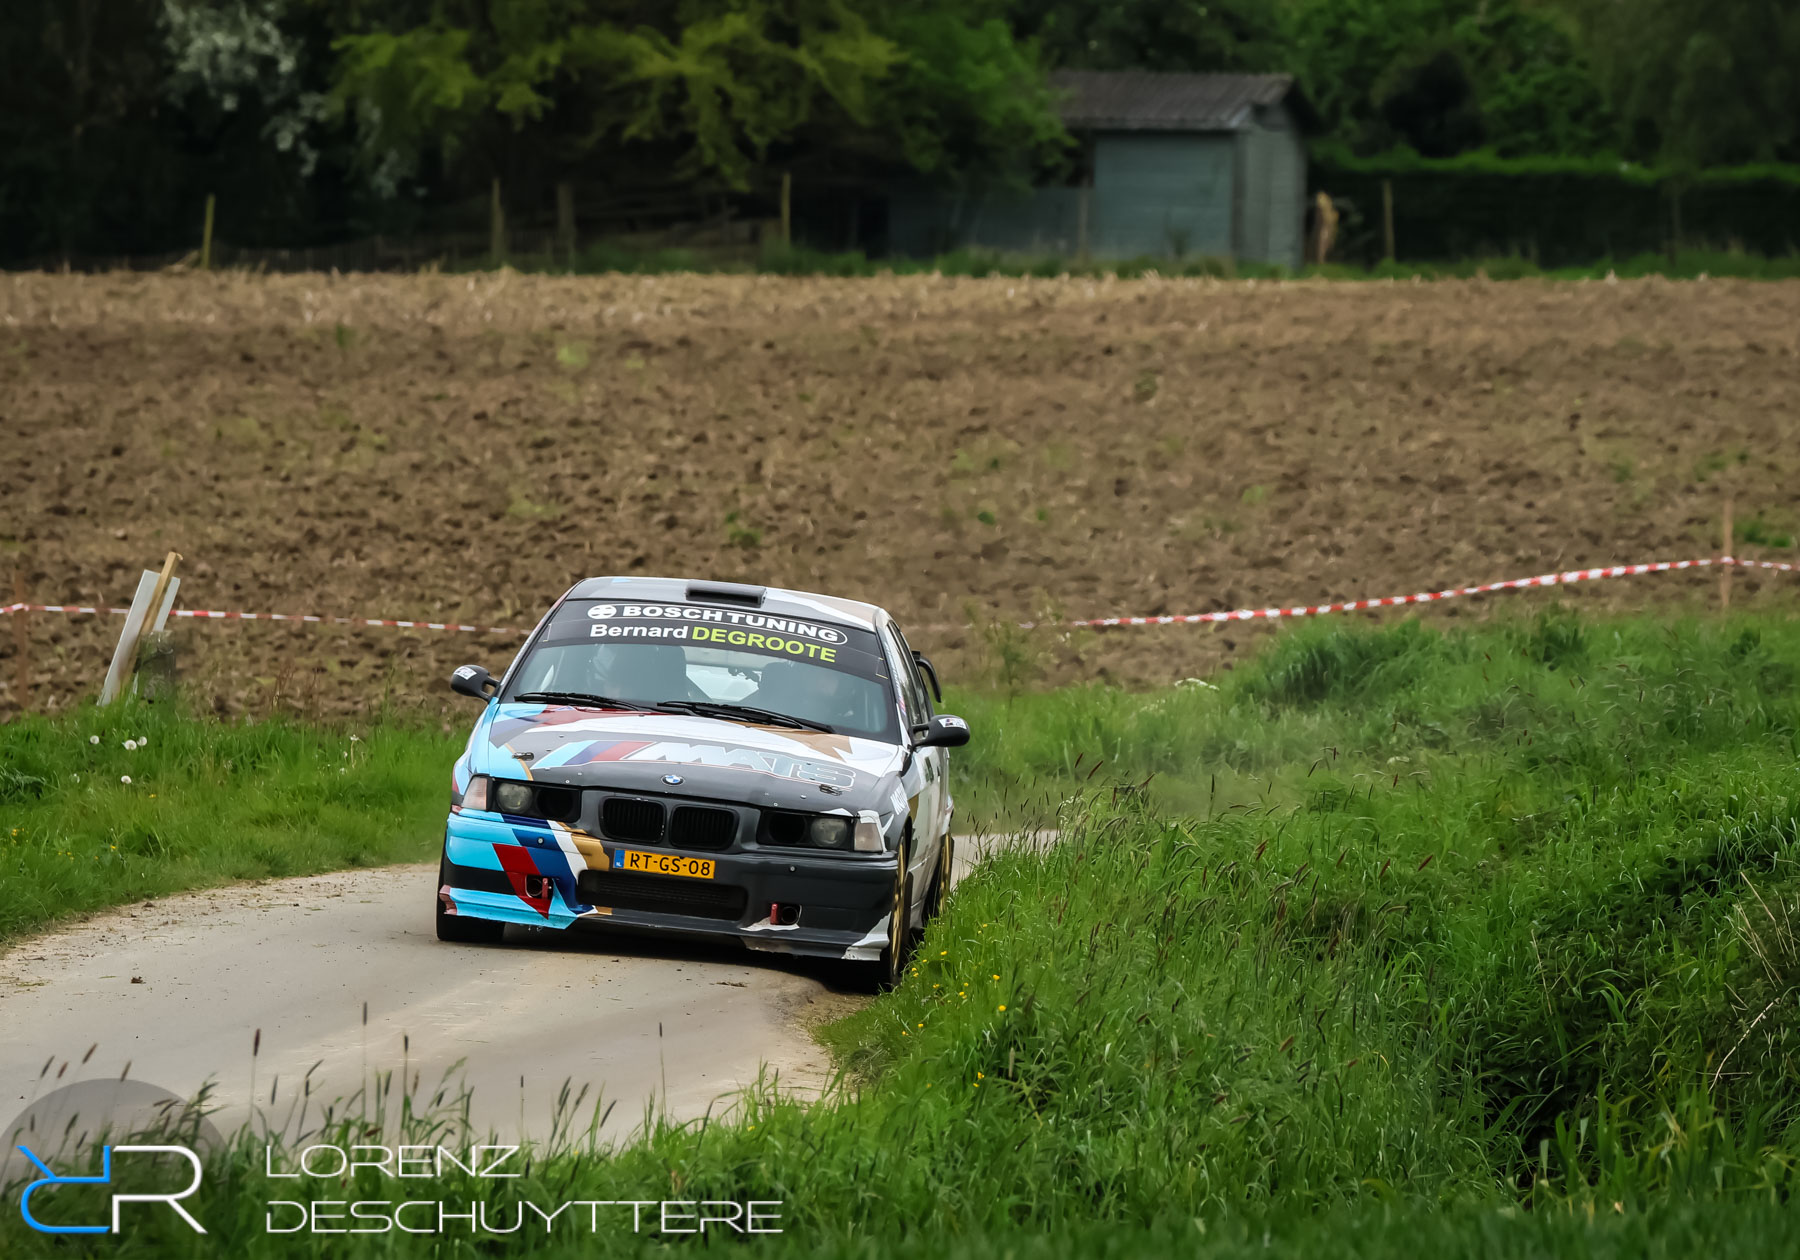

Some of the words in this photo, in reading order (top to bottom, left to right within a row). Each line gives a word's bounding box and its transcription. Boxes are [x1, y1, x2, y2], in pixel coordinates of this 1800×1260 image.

[622, 606, 726, 622] BOSCH
[727, 612, 839, 642] TUNING
[590, 624, 689, 639] Bernard
[691, 626, 837, 663] DEGROOTE
[630, 853, 711, 876] RT-GS-08
